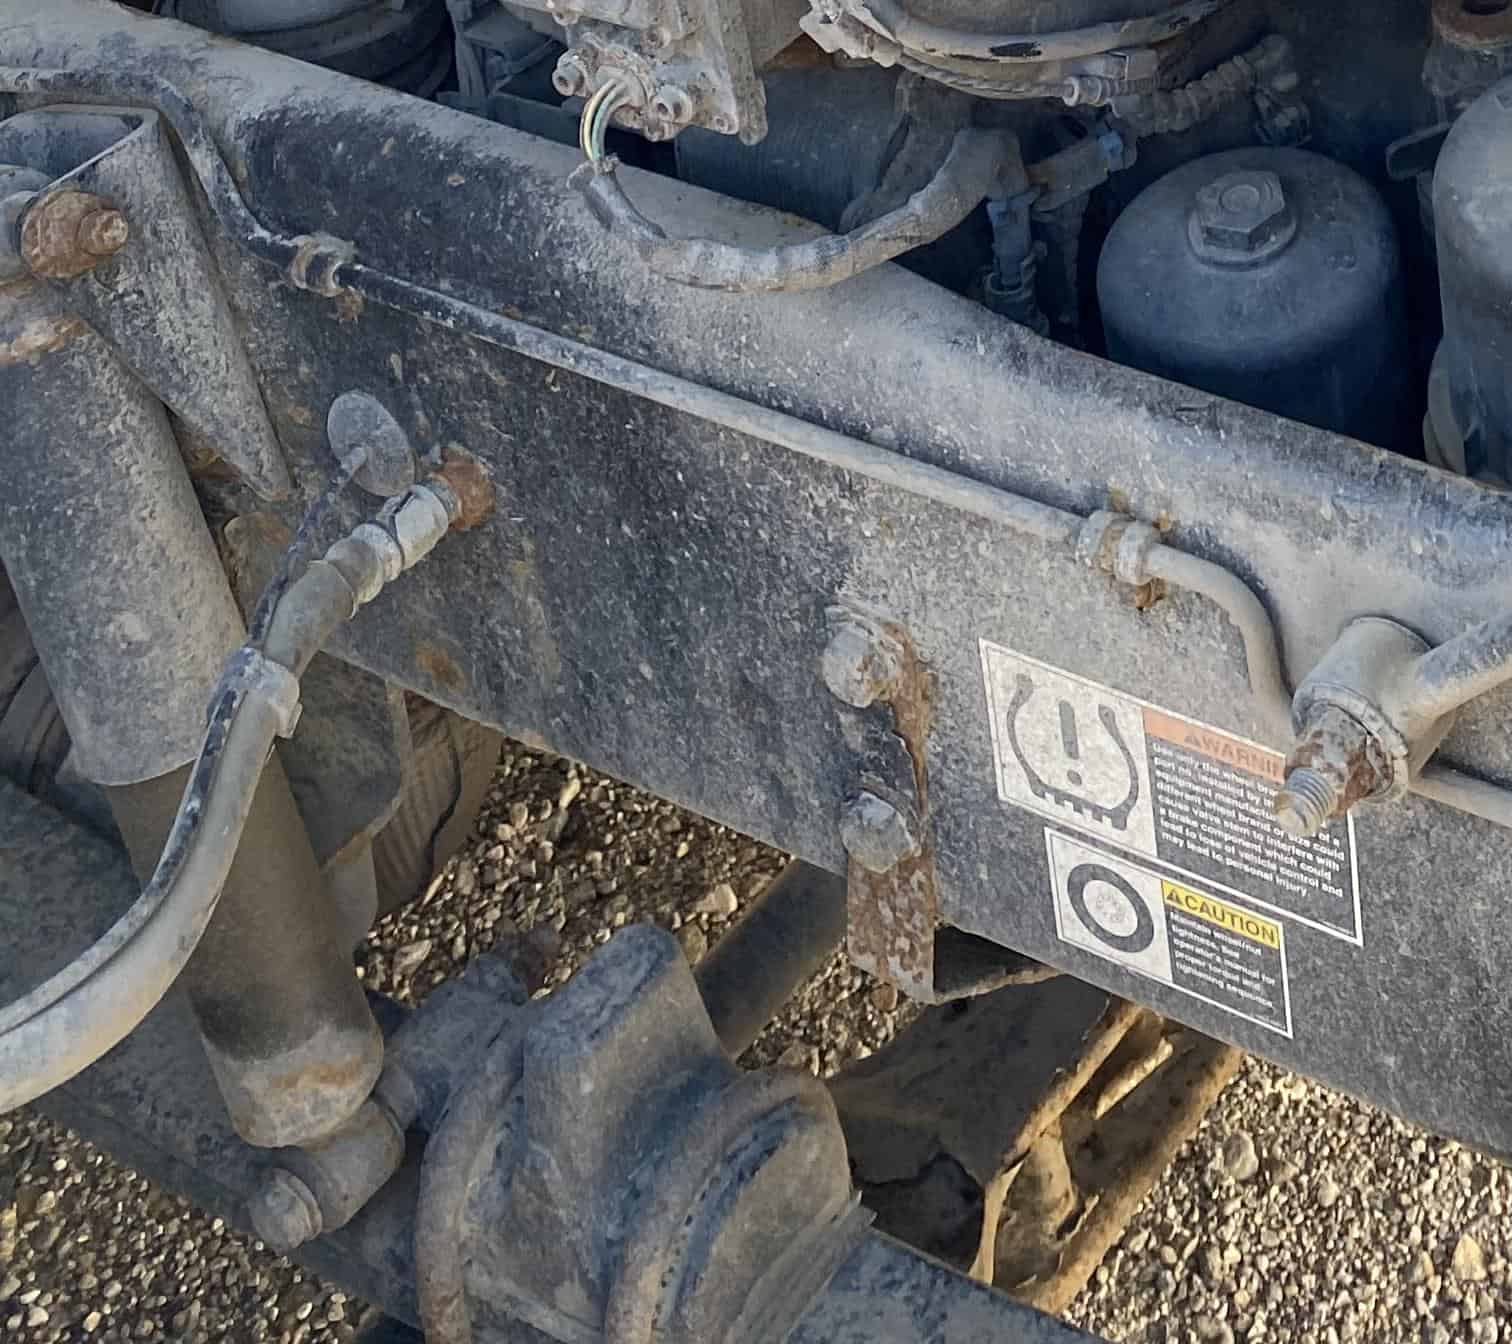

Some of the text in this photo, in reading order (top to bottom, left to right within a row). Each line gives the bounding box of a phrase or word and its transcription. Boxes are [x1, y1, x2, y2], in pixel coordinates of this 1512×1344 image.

[1155, 767, 1212, 797] equipment
[1155, 778, 1201, 805] different
[1204, 799, 1235, 818] wheel
[1237, 810, 1271, 833] brand
[1312, 841, 1345, 861] could
[1157, 793, 1189, 813] cause
[1191, 806, 1220, 825] valve
[1222, 818, 1249, 836] stem
[1251, 829, 1264, 842] to
[1266, 834, 1313, 861] interfere
[1315, 854, 1340, 873] with
[1167, 807, 1198, 829] brake
[1200, 823, 1261, 853] component
[1263, 847, 1298, 868] which
[1299, 860, 1332, 881] could
[1160, 817, 1183, 835] lead
[1184, 827, 1196, 840] to
[1223, 842, 1235, 854] of
[1237, 849, 1277, 872] vehicle
[1279, 865, 1319, 888] control
[1321, 881, 1343, 898] and
[1161, 830, 1184, 848] may
[1186, 838, 1209, 857] lead
[1224, 855, 1273, 882] personal
[1184, 894, 1274, 942] CAUTION
[1223, 958, 1259, 979] manual
